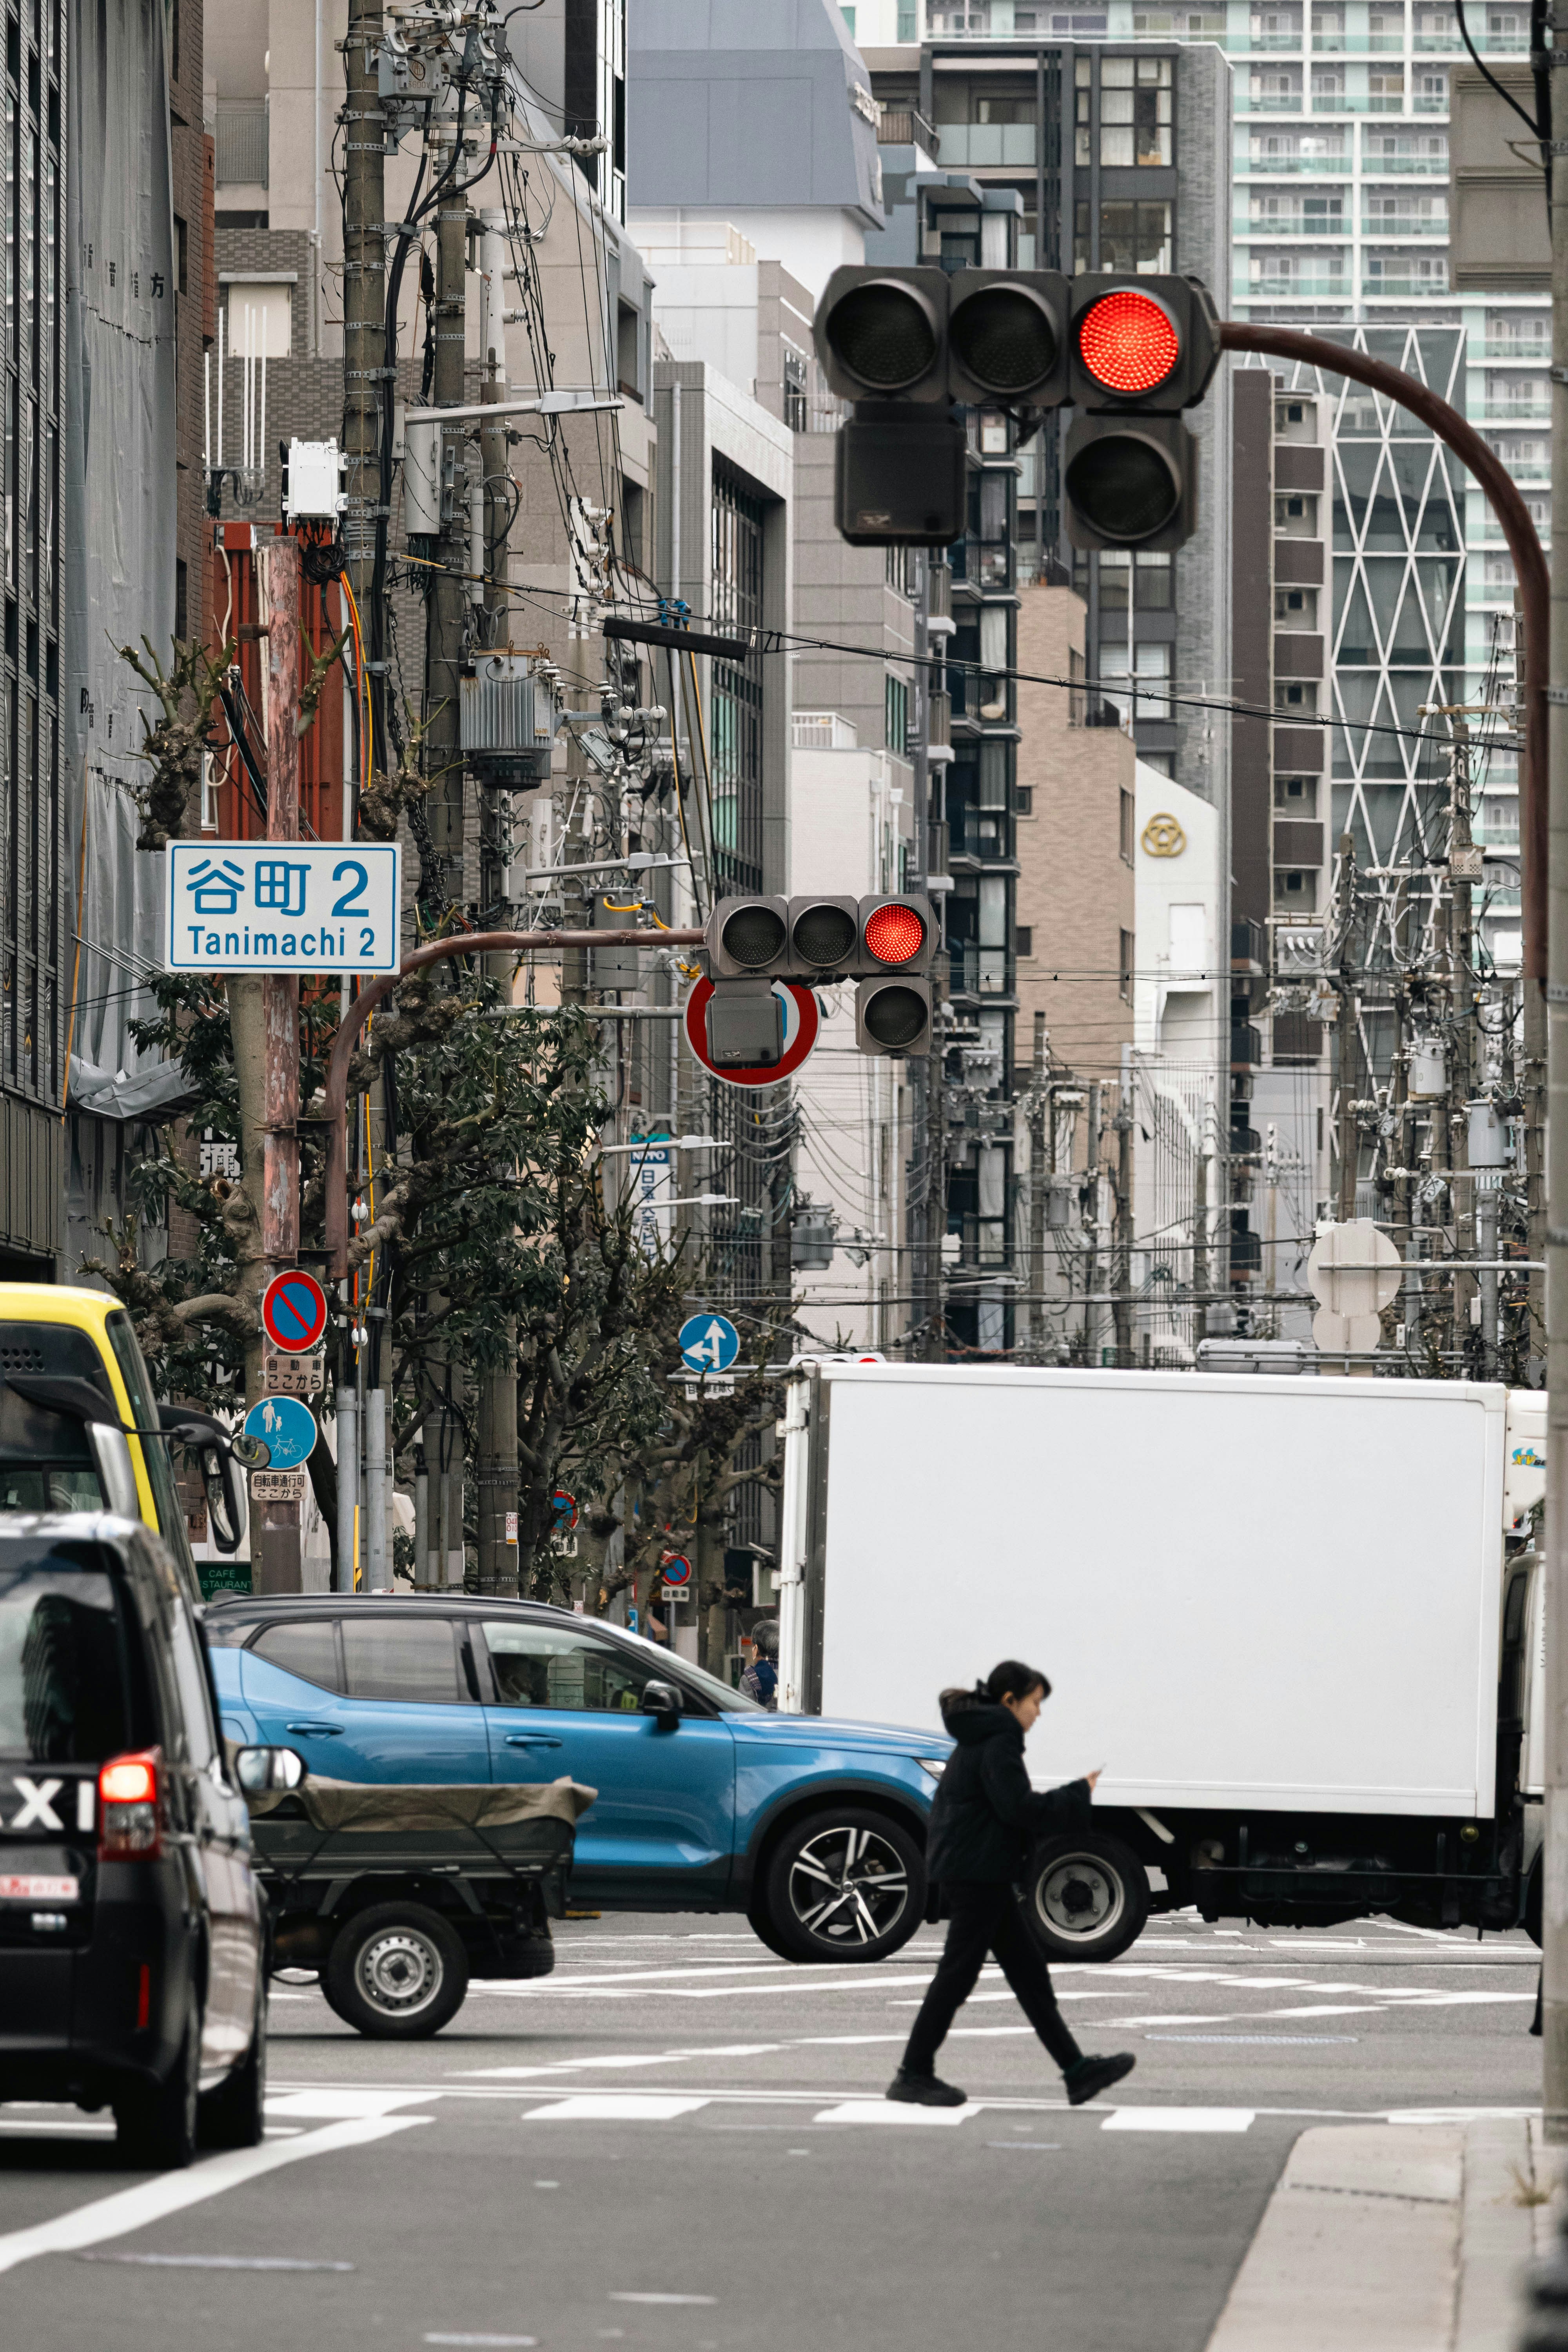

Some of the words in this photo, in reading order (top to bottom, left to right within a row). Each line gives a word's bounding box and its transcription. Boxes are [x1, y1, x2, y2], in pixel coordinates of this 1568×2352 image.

[187, 926, 345, 956] Tanimachi
[359, 927, 375, 956] 2
[269, 1359, 321, 1371] 自動車
[268, 1374, 321, 1390] ここから
[254, 1474, 305, 1487] 自転車通行可
[257, 1488, 302, 1499] ここから
[0, 1777, 96, 1833] XI
